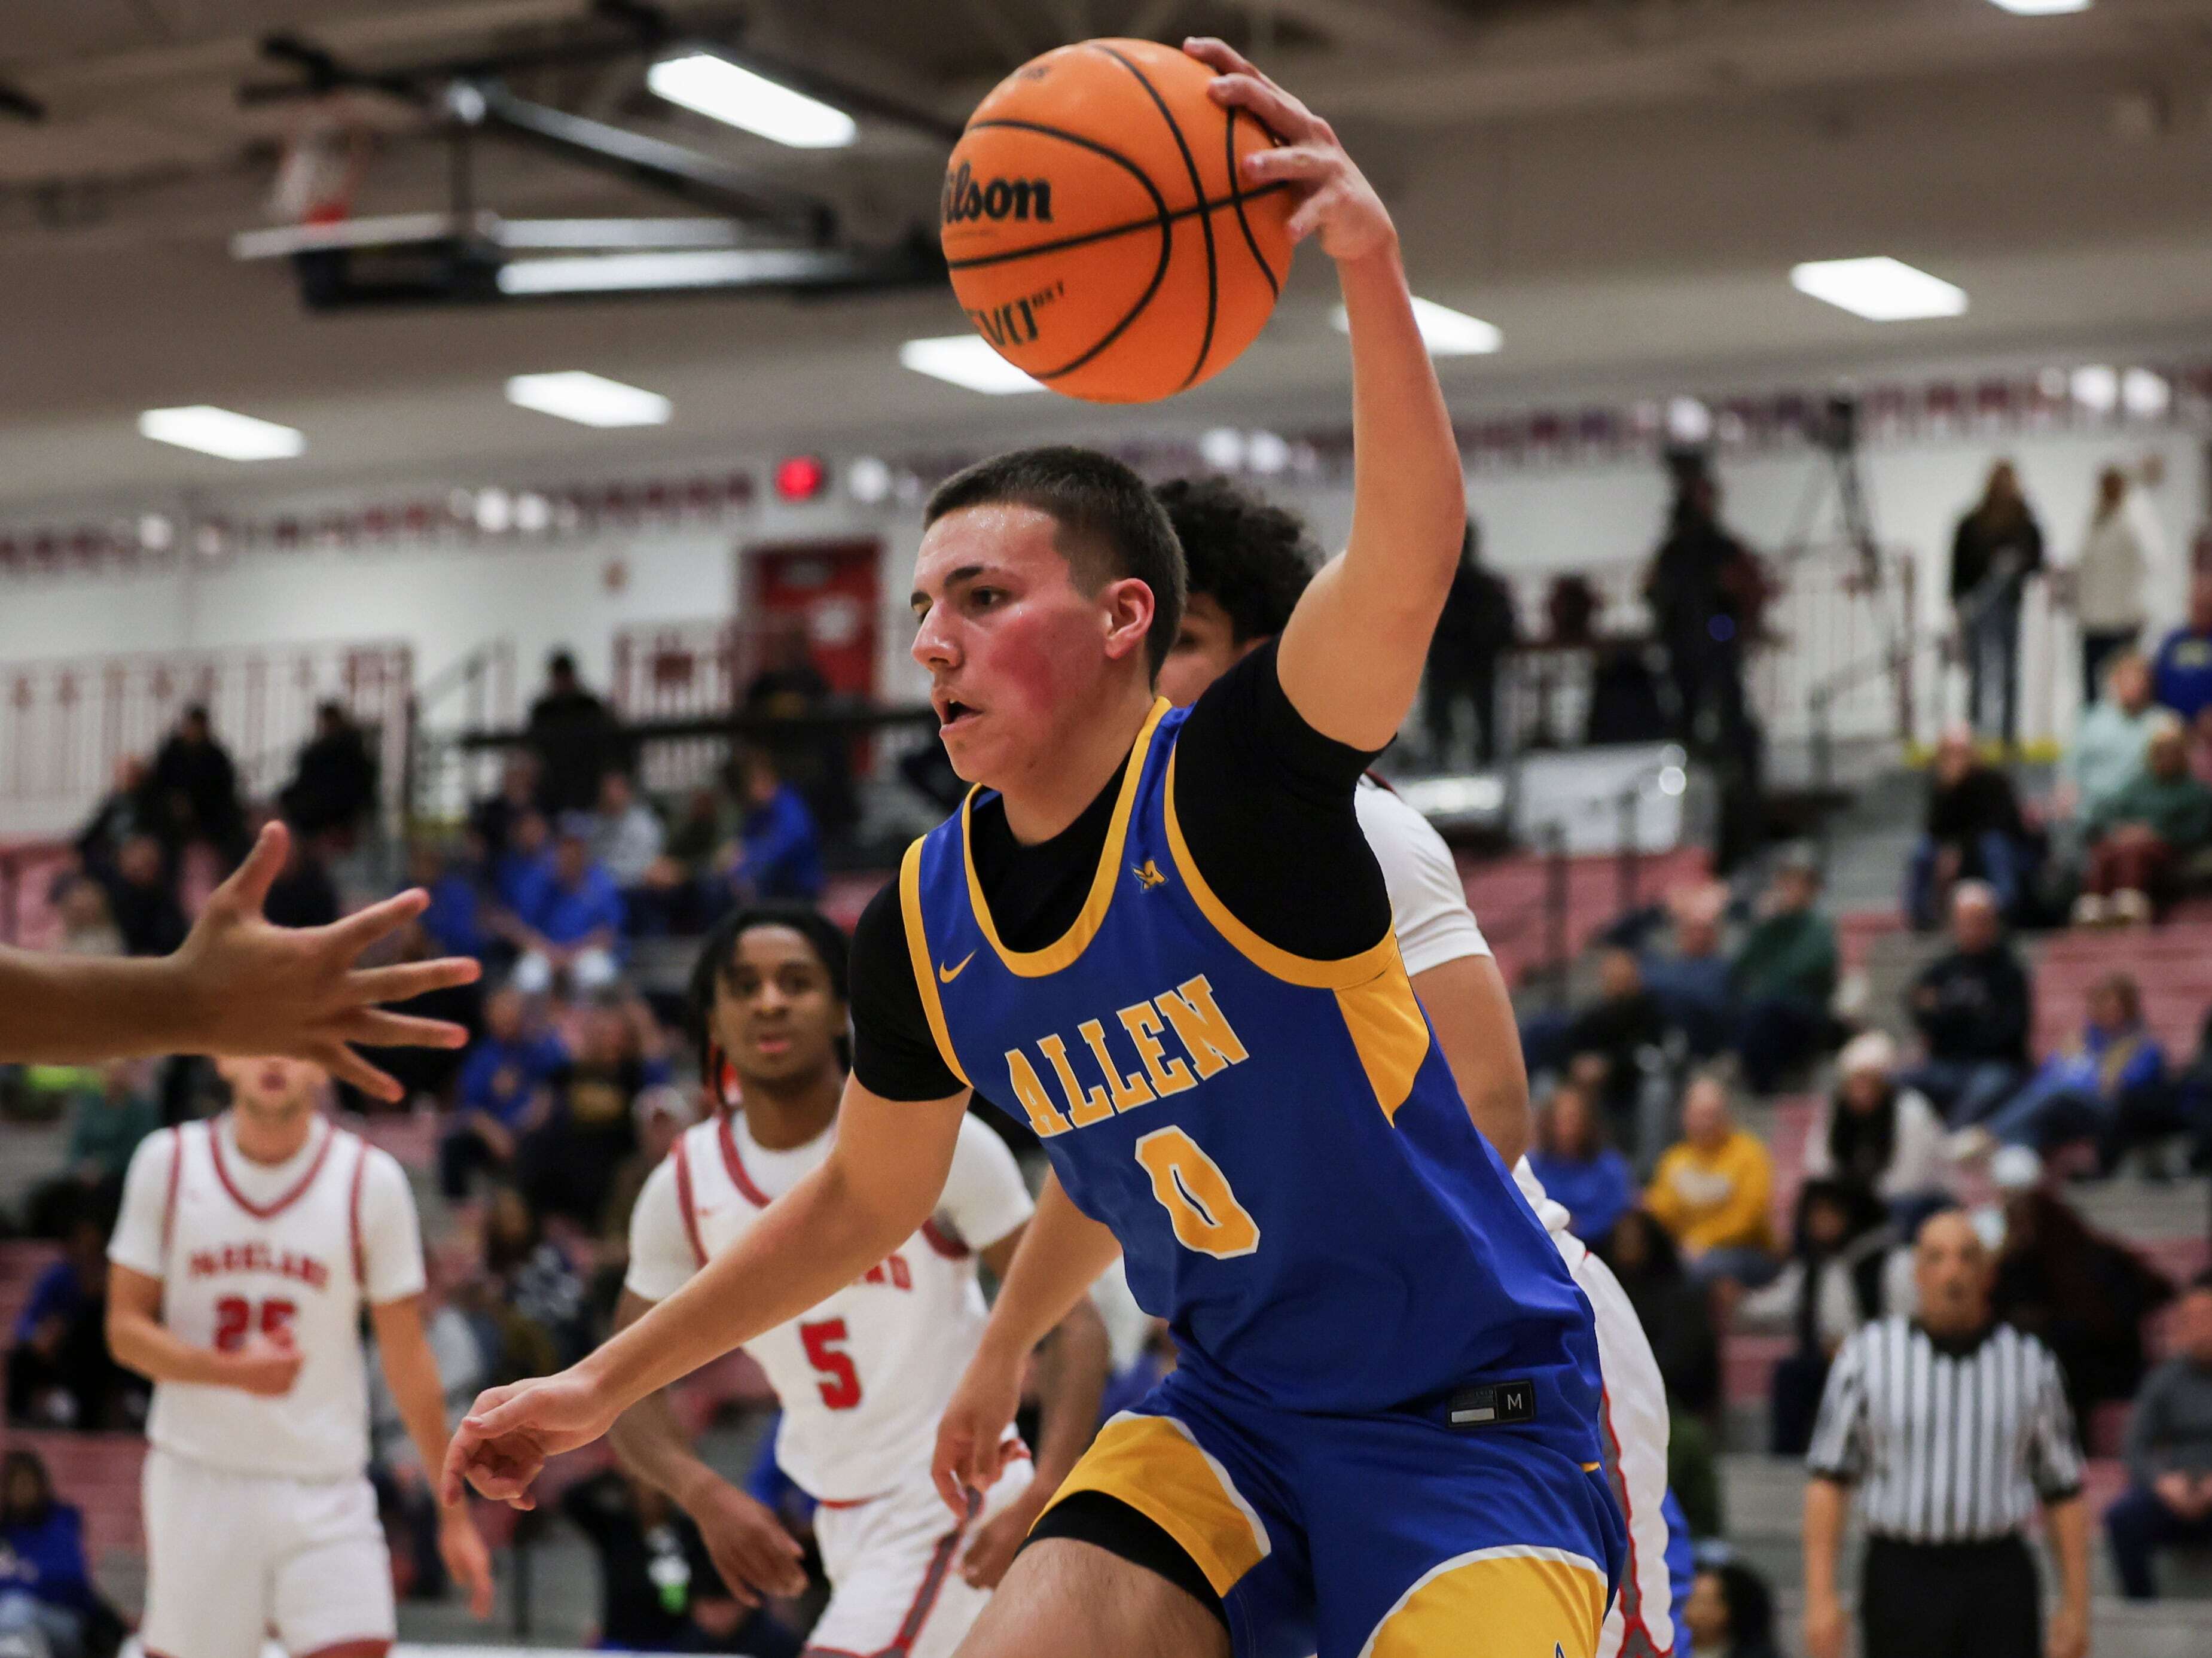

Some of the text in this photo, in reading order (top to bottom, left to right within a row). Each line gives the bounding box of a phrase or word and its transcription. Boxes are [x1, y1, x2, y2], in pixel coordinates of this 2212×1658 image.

[1005, 973, 1249, 1138] ALLEN
[1134, 1124, 1261, 1260] 0
[215, 1295, 297, 1352] 25
[800, 1318, 862, 1410] 5
[1507, 1393, 1522, 1410] M
